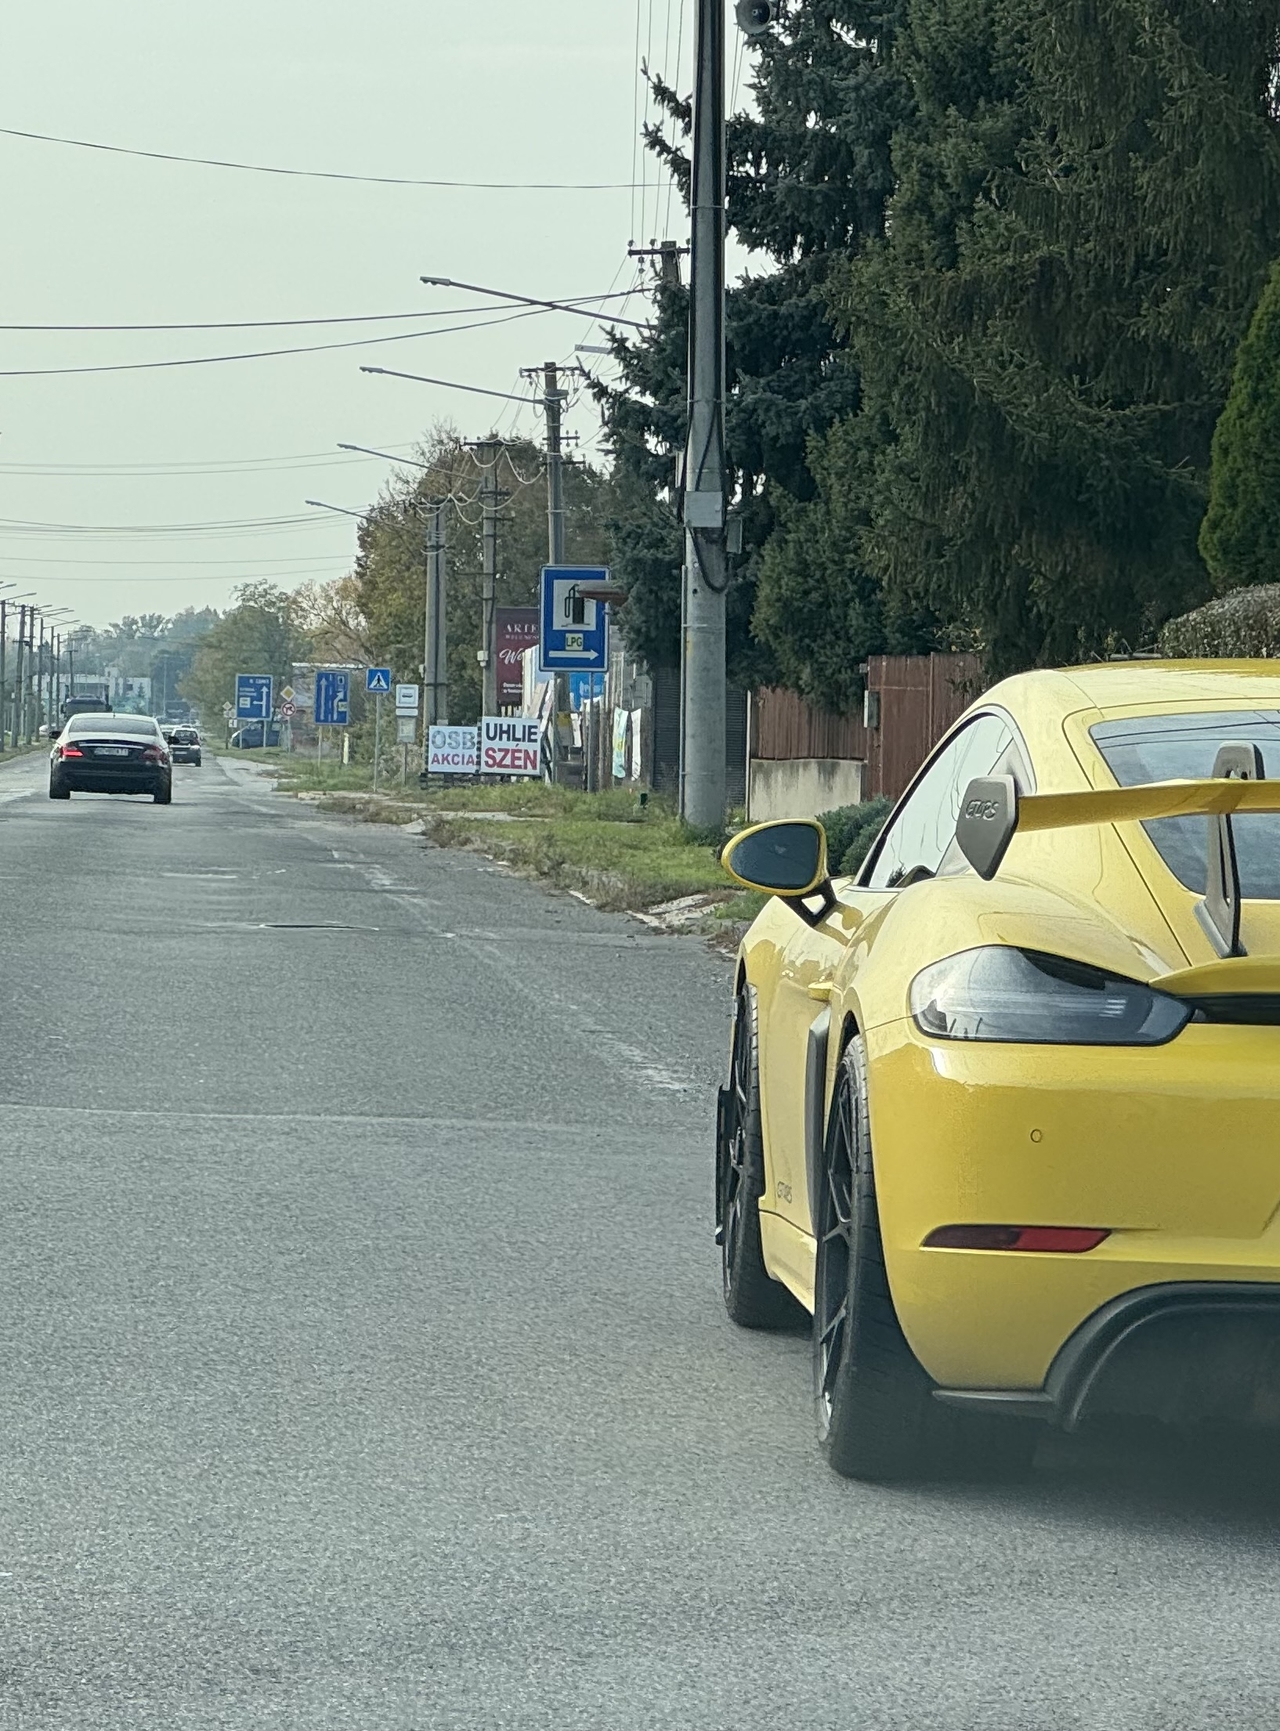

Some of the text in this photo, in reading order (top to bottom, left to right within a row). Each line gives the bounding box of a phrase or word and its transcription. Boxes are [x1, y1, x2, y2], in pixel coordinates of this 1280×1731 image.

[566, 637, 583, 647] LPG
[431, 730, 476, 750] OSB
[485, 722, 538, 743] UHLIE
[431, 752, 475, 766] AKCIA
[484, 743, 538, 770] SZÉN
